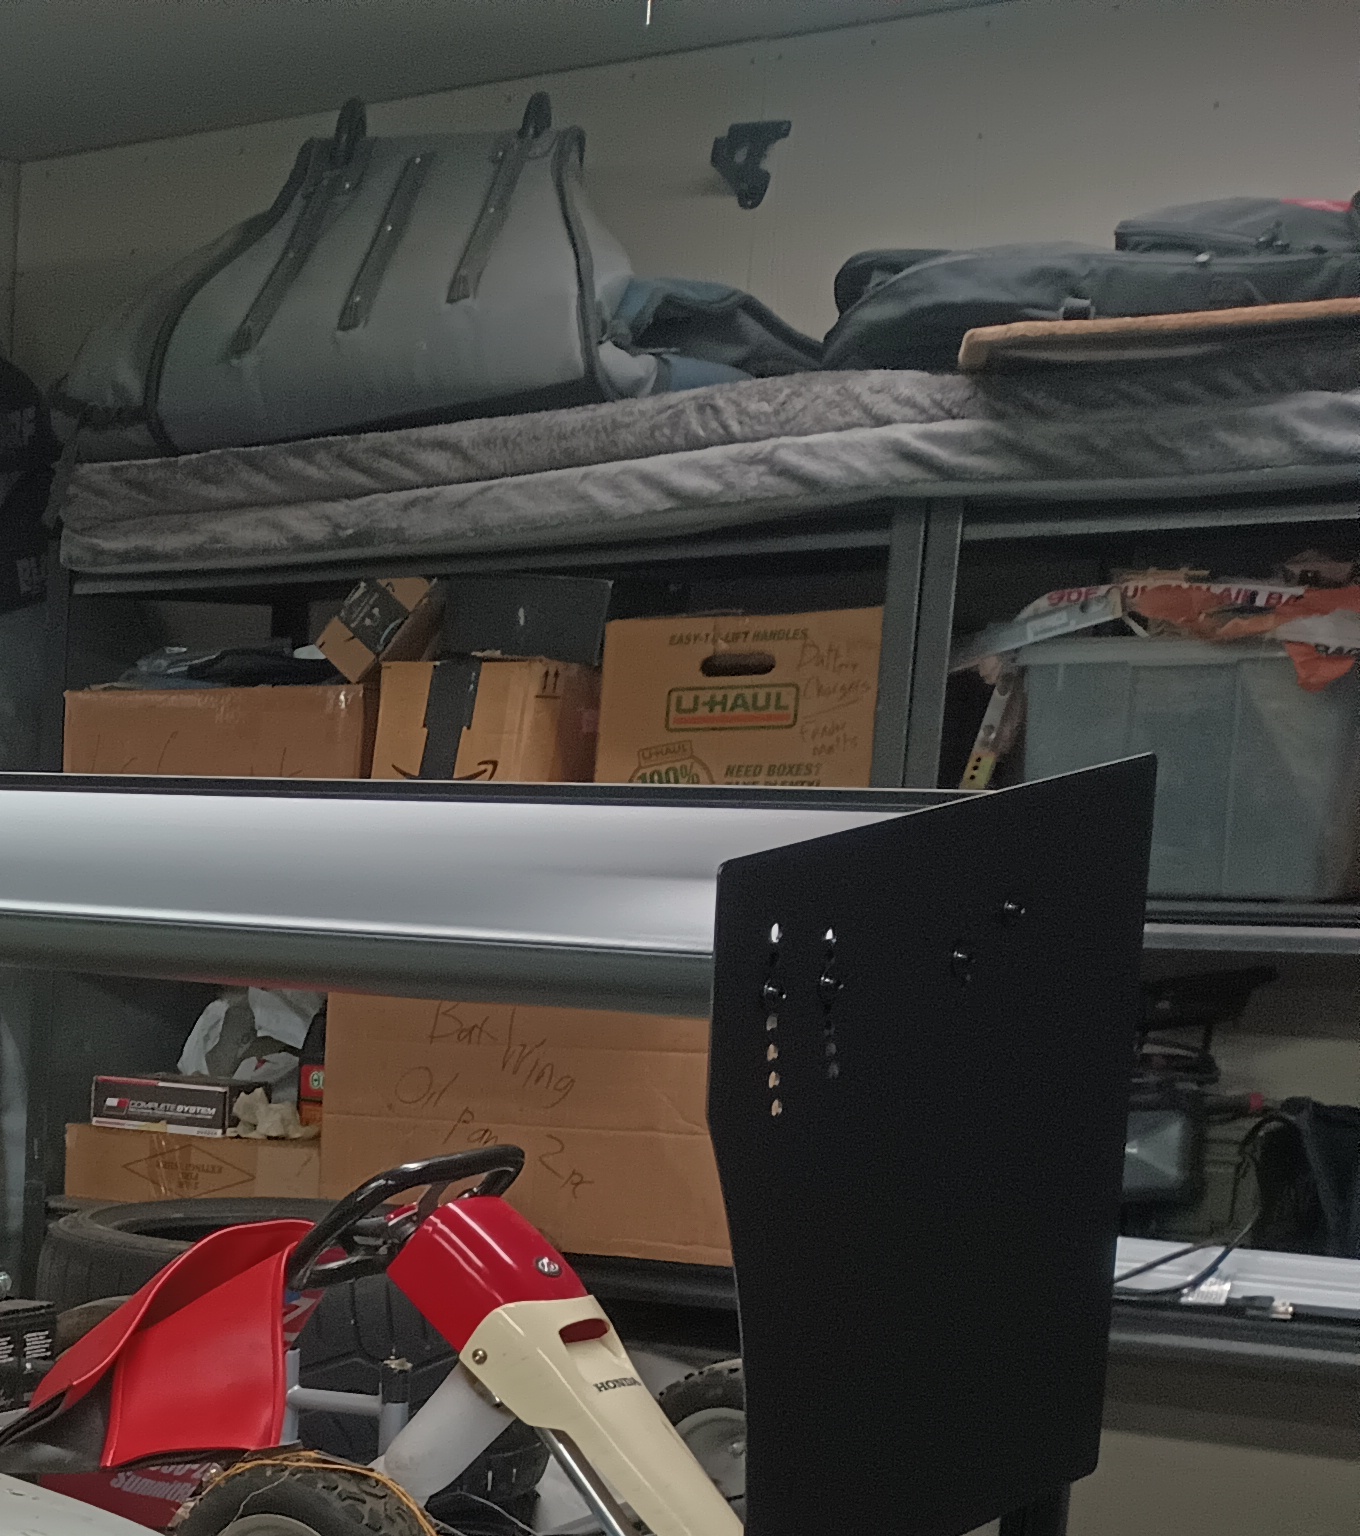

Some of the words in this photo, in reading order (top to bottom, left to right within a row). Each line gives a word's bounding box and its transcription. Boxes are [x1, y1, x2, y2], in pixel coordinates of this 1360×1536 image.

[751, 628, 809, 642] HANDLES
[674, 690, 790, 714] U-HAUL
[724, 765, 764, 778] NEED
[765, 763, 822, 777] BOXES?
[501, 1007, 577, 1109] Wing
[129, 1100, 177, 1112] COMPLETE
[176, 1104, 217, 1116] SYSTEM
[442, 1107, 499, 1147] Pan
[593, 1377, 642, 1393] HONDA
